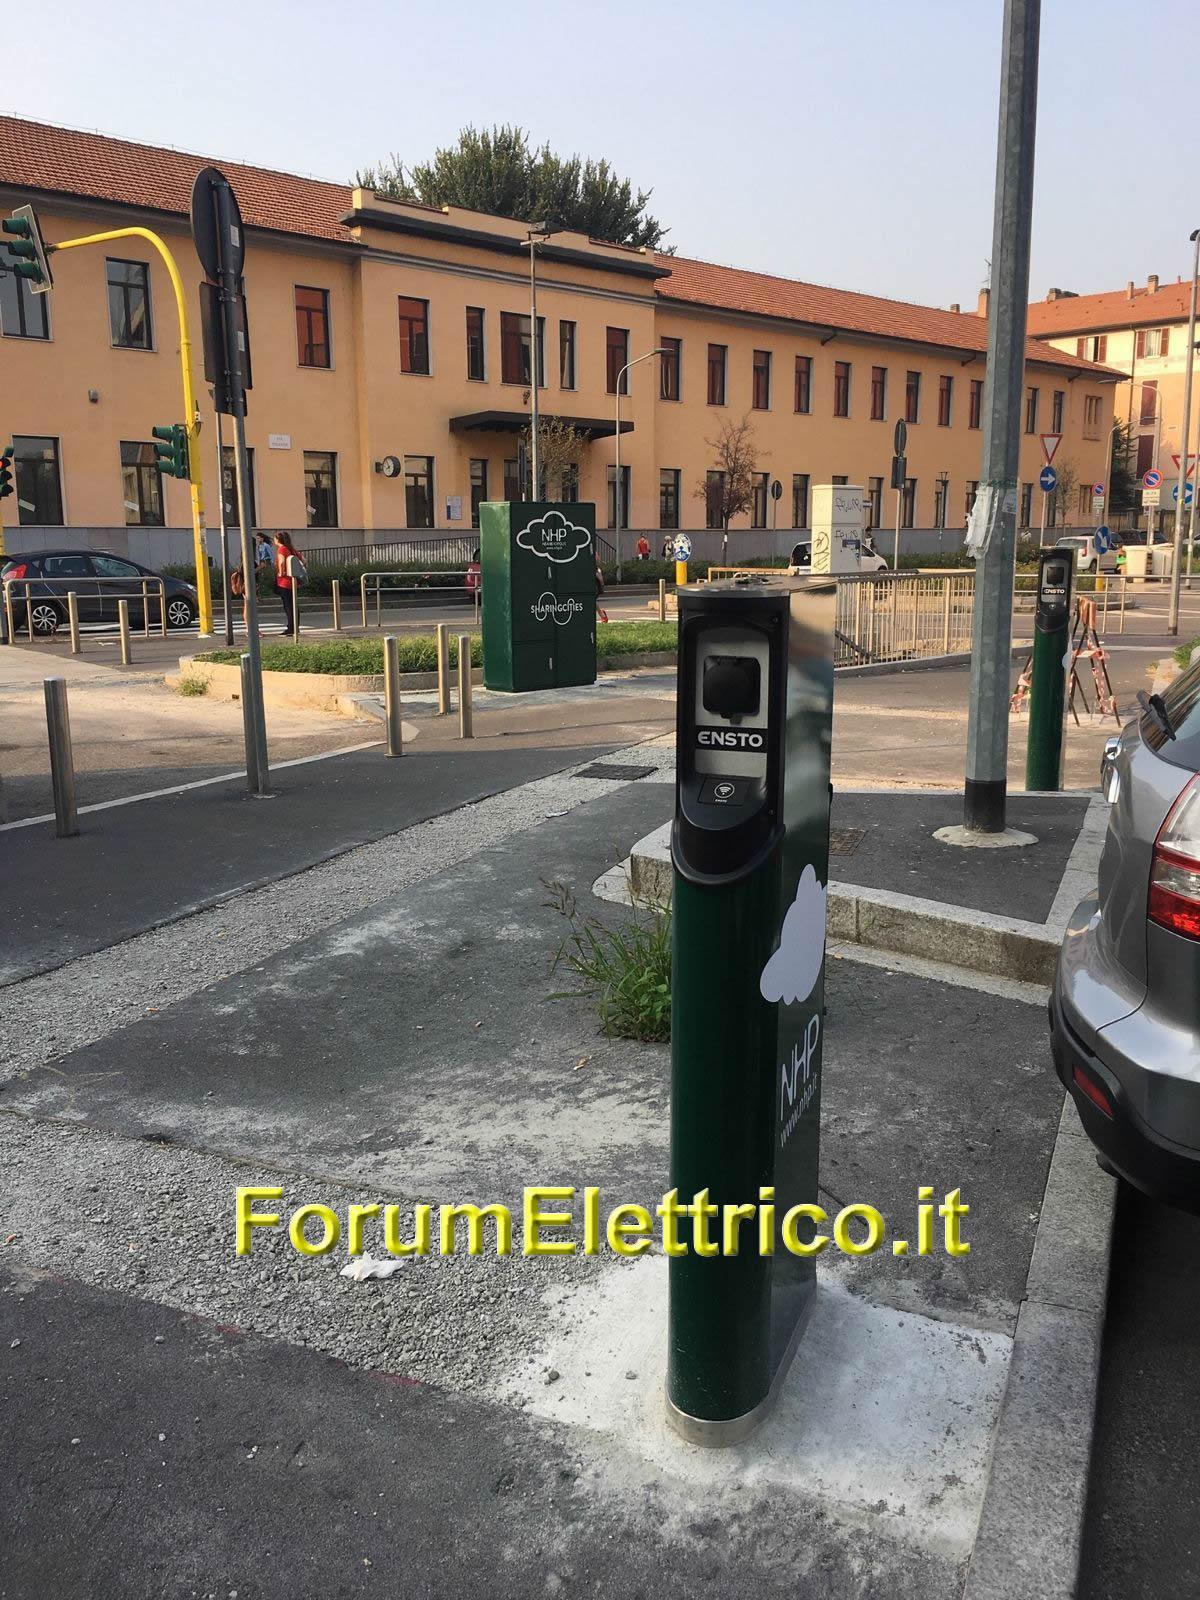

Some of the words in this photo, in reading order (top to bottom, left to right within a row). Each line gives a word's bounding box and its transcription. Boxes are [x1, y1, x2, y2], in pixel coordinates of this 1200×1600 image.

[541, 528, 567, 542] NHP
[697, 730, 763, 748] ENSTO
[780, 1013, 820, 1121] NHP
